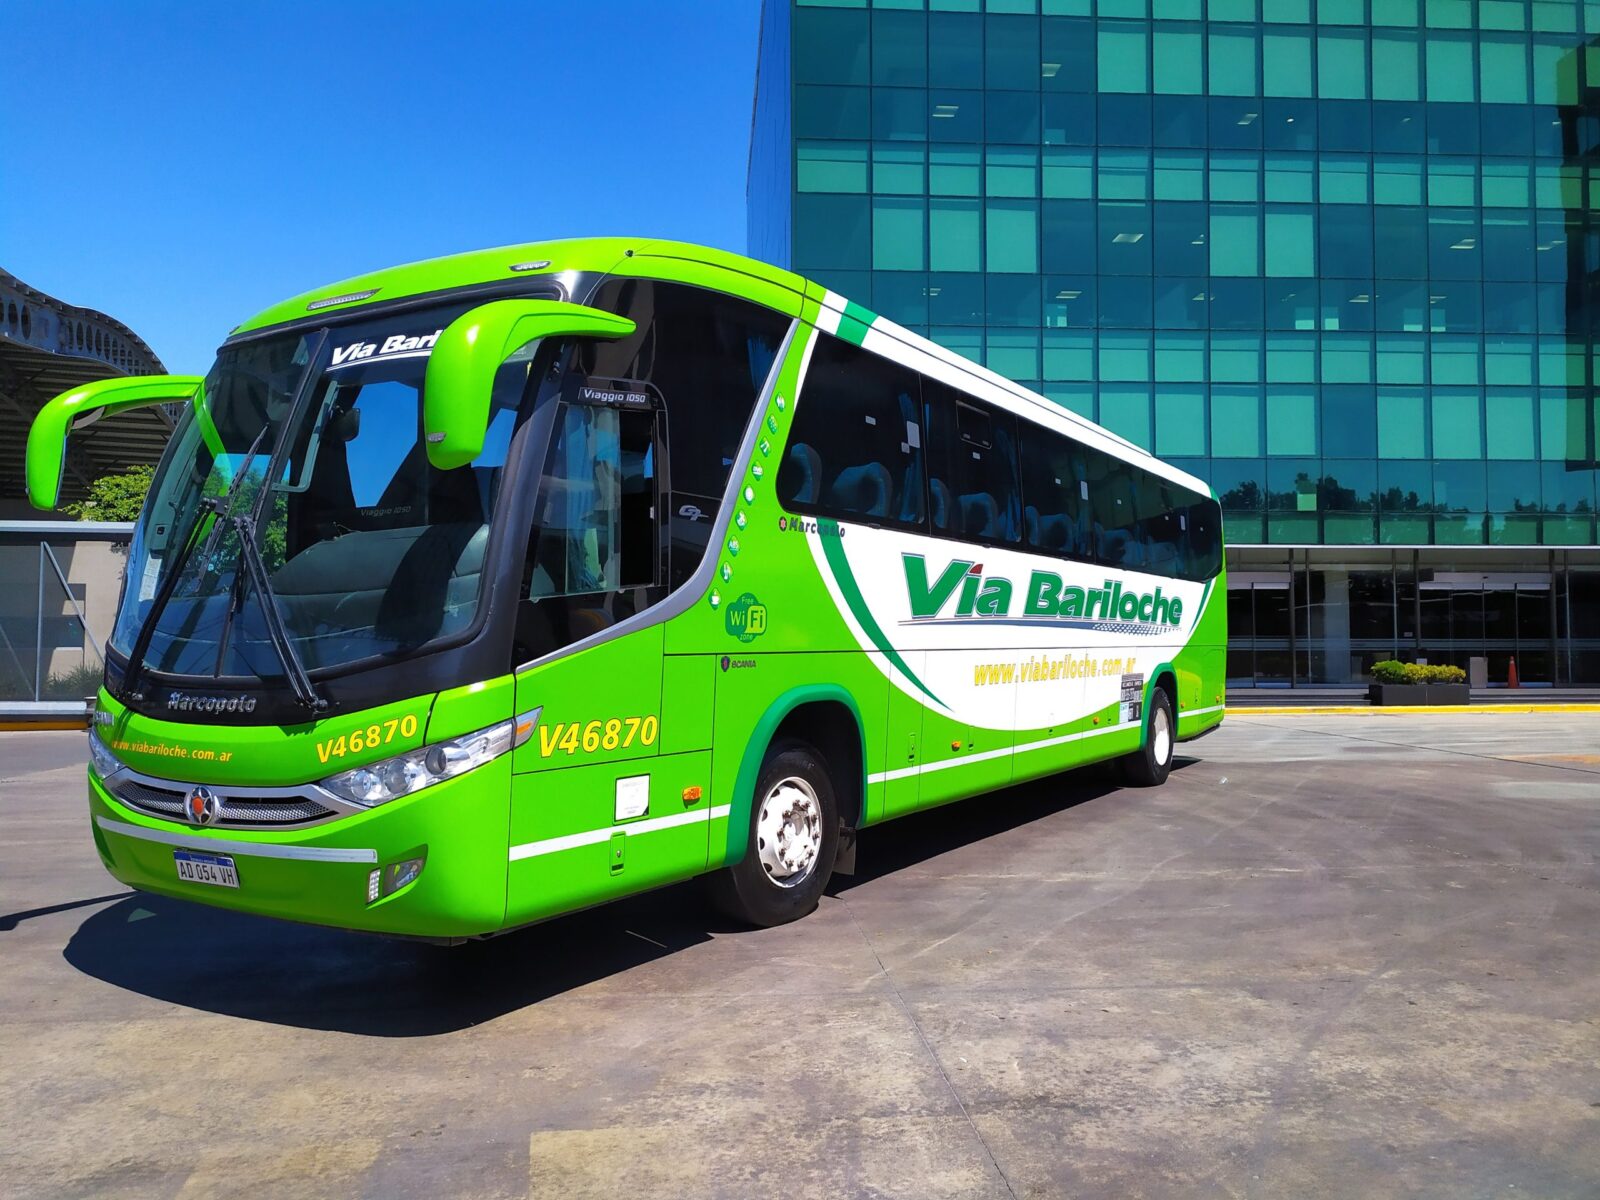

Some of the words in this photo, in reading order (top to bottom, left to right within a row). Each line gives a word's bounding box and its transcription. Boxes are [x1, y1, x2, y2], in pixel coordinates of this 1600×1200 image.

[332, 341, 377, 365] Via
[584, 388, 624, 402] Viaggio
[626, 393, 646, 403] 1050
[741, 595, 755, 605] Free
[901, 551, 1013, 619] Via
[1023, 569, 1184, 627] Bariloche
[974, 653, 1137, 687] www.viabariloche.com.ar
[167, 691, 257, 715] Marcopolo
[315, 712, 419, 764] V46870
[538, 714, 659, 758] V46870
[179, 861, 194, 879] AD
[195, 863, 217, 882] 054
[218, 866, 235, 886] VH
